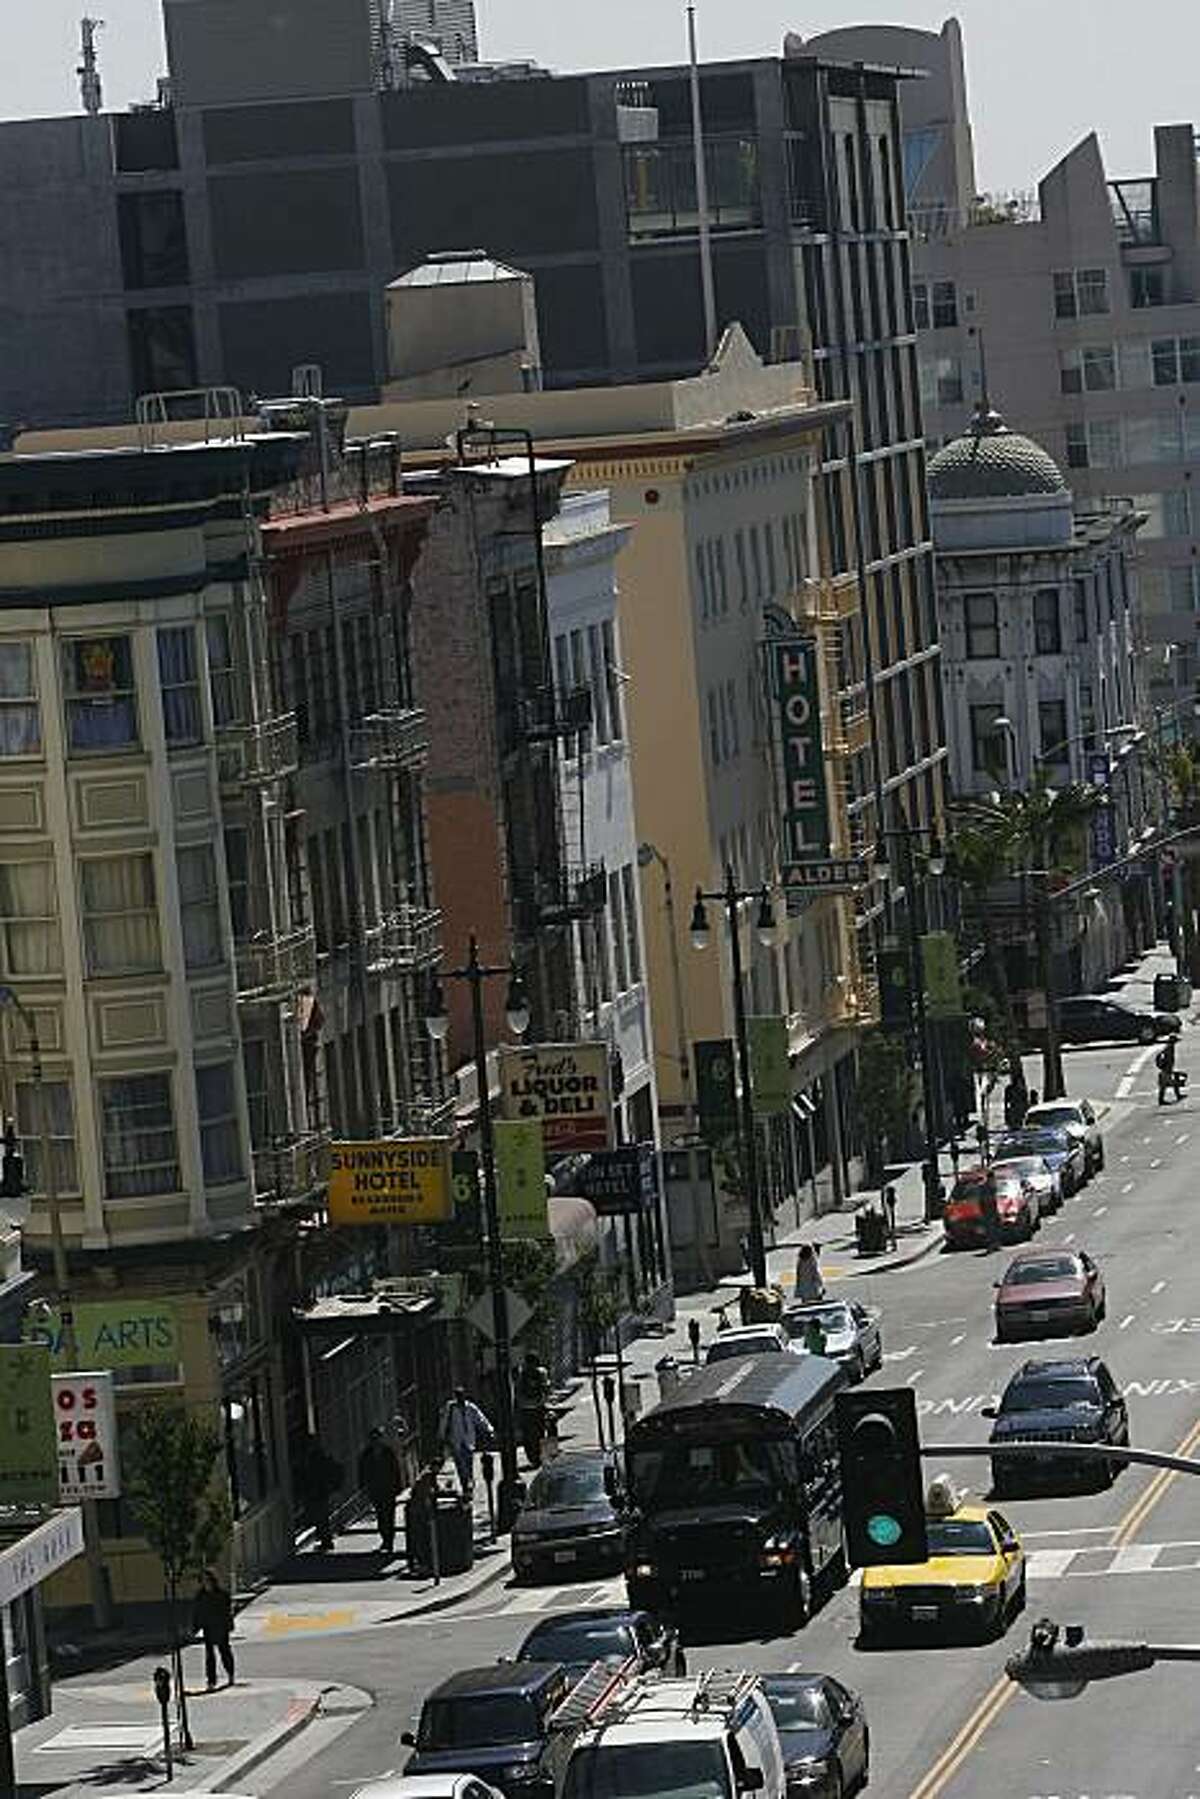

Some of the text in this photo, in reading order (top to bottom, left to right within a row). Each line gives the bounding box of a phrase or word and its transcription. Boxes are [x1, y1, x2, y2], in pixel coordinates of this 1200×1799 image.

[782, 650, 821, 852] HOTEL
[511, 1075, 599, 1098] LIQUOR
[519, 1096, 595, 1117] & DELI
[332, 1149, 444, 1170] SUNNYSIDE
[354, 1171, 421, 1191] HOTEL
[95, 1315, 173, 1351] ARTS
